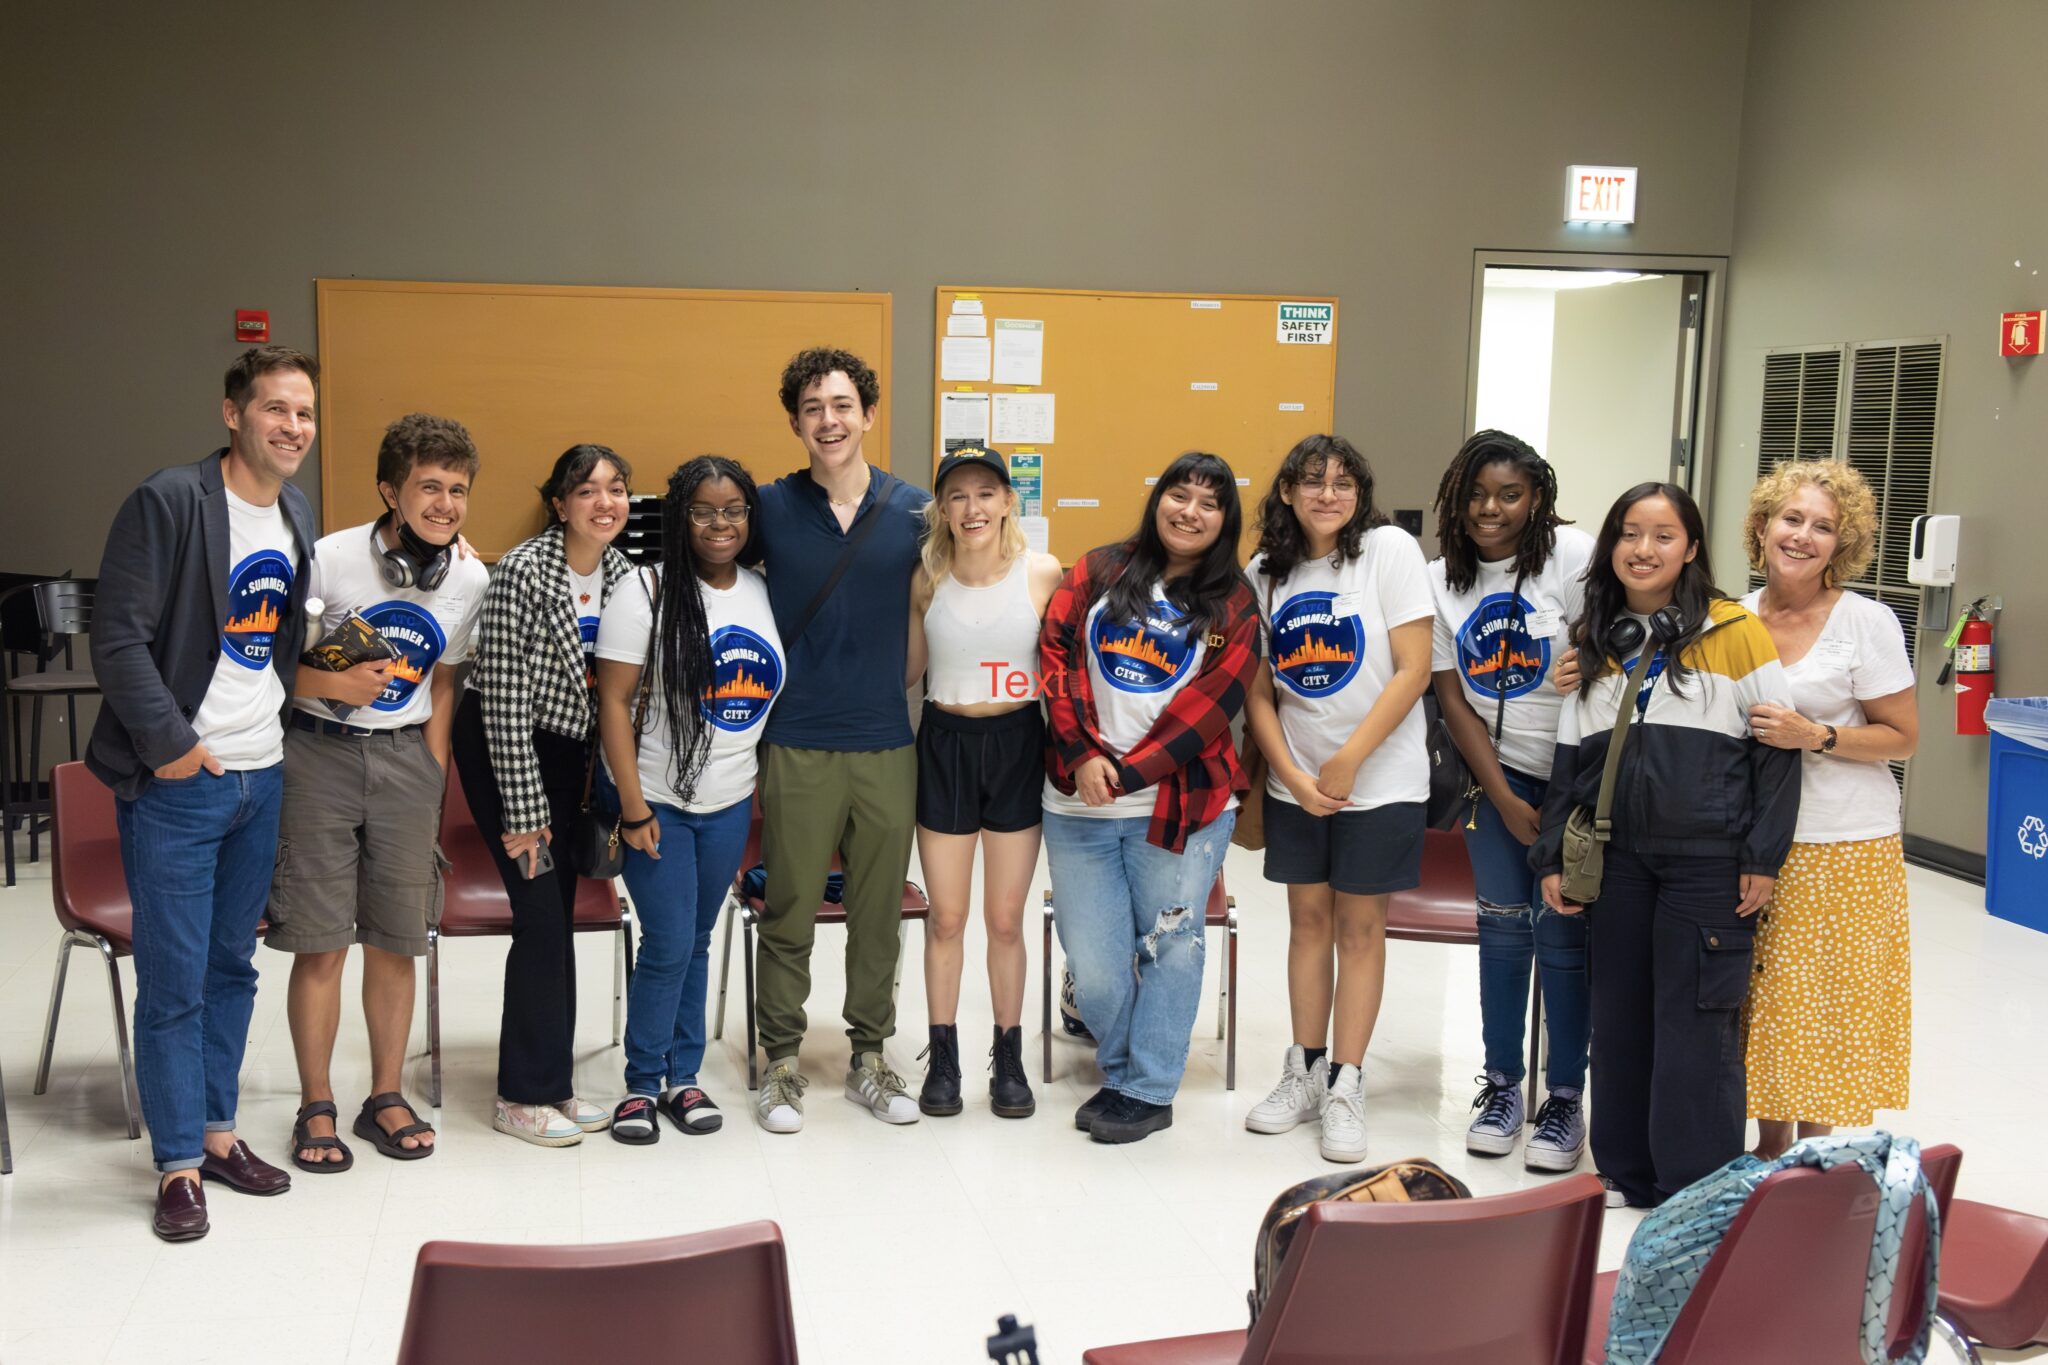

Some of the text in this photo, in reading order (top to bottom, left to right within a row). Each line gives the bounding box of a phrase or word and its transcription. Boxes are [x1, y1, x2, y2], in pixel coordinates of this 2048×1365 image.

[1580, 176, 1625, 212] EXIT
[1283, 306, 1328, 319] THINK
[1281, 321, 1329, 332] SAFETY
[1287, 333, 1323, 342] FIRST
[260, 564, 280, 575] ATC
[248, 577, 286, 595] SUMMER
[1301, 602, 1327, 613] ATC
[388, 612, 417, 627] ATC
[1286, 613, 1334, 631] SUMMER
[727, 638, 748, 647] ATC
[720, 648, 760, 664] SUMMER
[1114, 666, 1148, 684] CITY
[1302, 674, 1331, 687] CITY
[722, 709, 752, 720] CITY
[624, 1100, 647, 1112] NIKE
